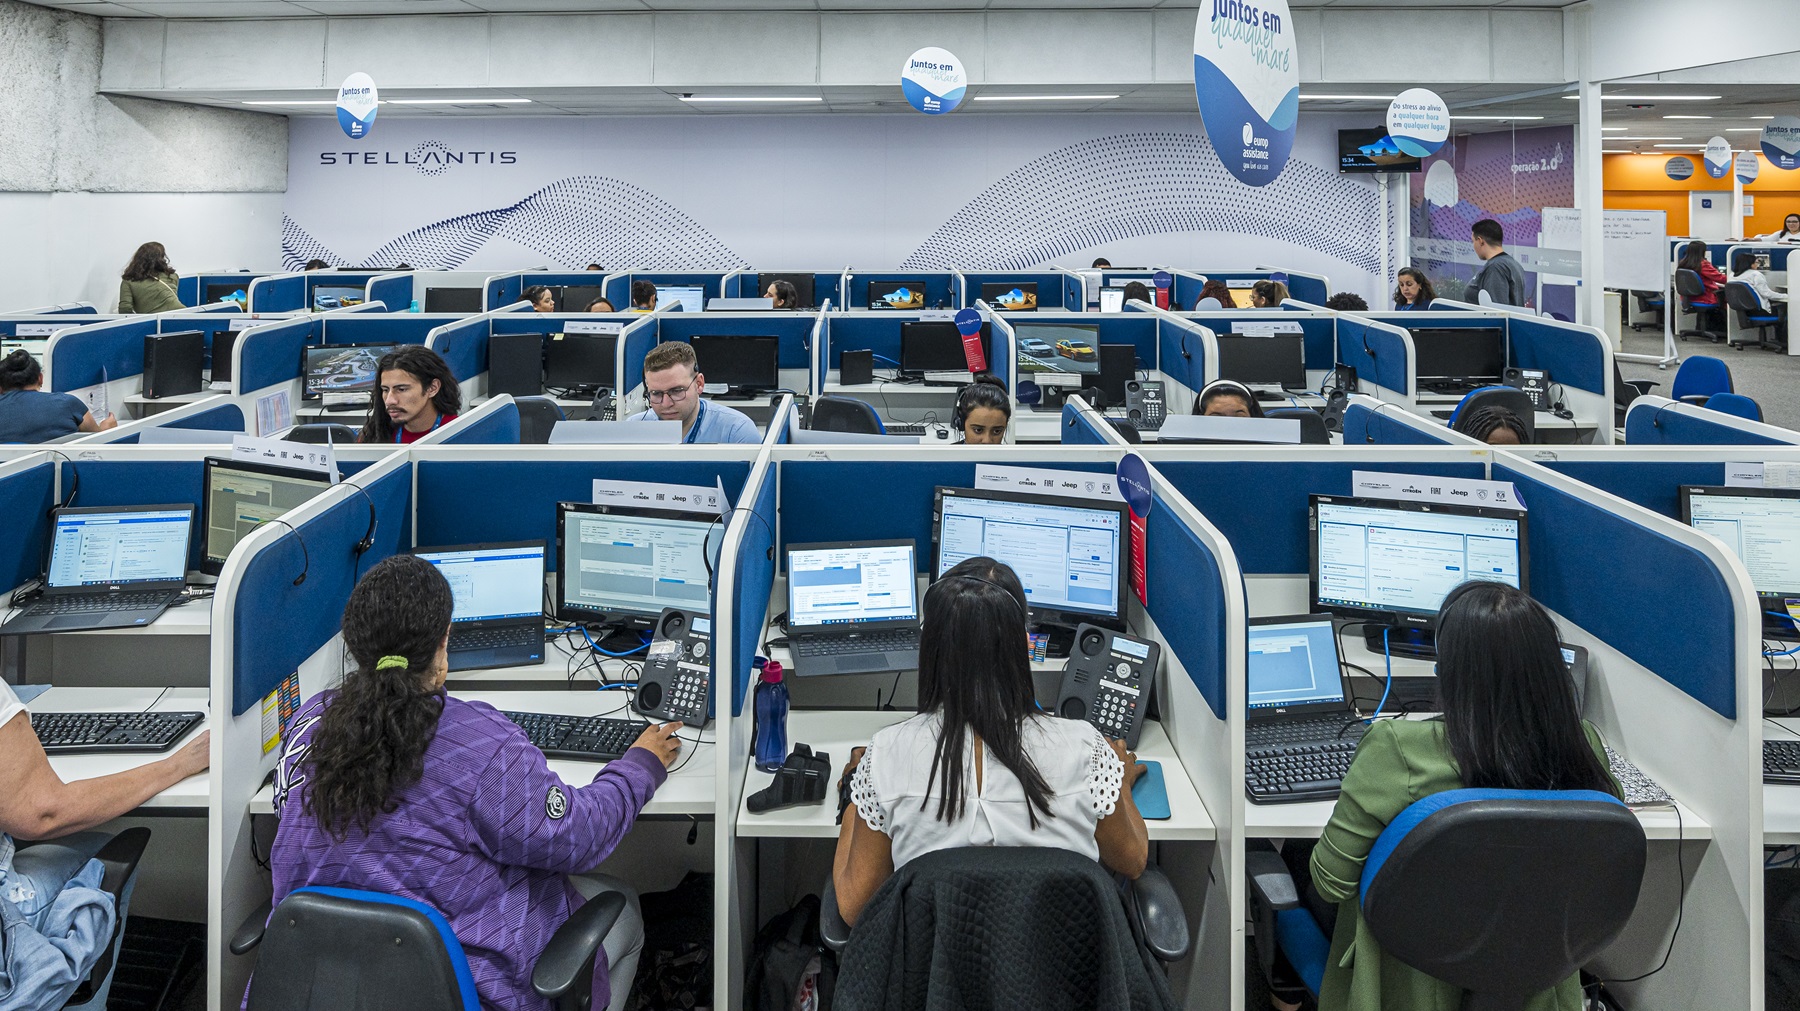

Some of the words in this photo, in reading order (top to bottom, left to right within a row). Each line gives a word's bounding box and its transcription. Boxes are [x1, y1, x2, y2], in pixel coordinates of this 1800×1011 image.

[1211, 0, 1259, 27] Juntos
[1262, 11, 1281, 34] em
[1211, 13, 1276, 57] qualquer
[910, 59, 937, 70] Juntos
[1256, 47, 1290, 73] maré
[342, 87, 361, 97] Juntos
[1402, 103, 1418, 111] stress
[1398, 111, 1425, 121] qualquer
[1426, 112, 1439, 121] hora
[1403, 121, 1430, 131] qualquer
[1431, 122, 1447, 132] lugar.
[1766, 125, 1788, 134] Juntos
[1253, 137, 1269, 149] europ
[320, 151, 517, 165] STELLANTIS
[1242, 147, 1269, 160] assistance
[1540, 157, 1558, 171] 2.0
[293, 453, 305, 461] Jeep
[1062, 481, 1078, 489] Jeep
[1120, 476, 1150, 496] STELLANTIS
[1450, 488, 1469, 497] Jeep
